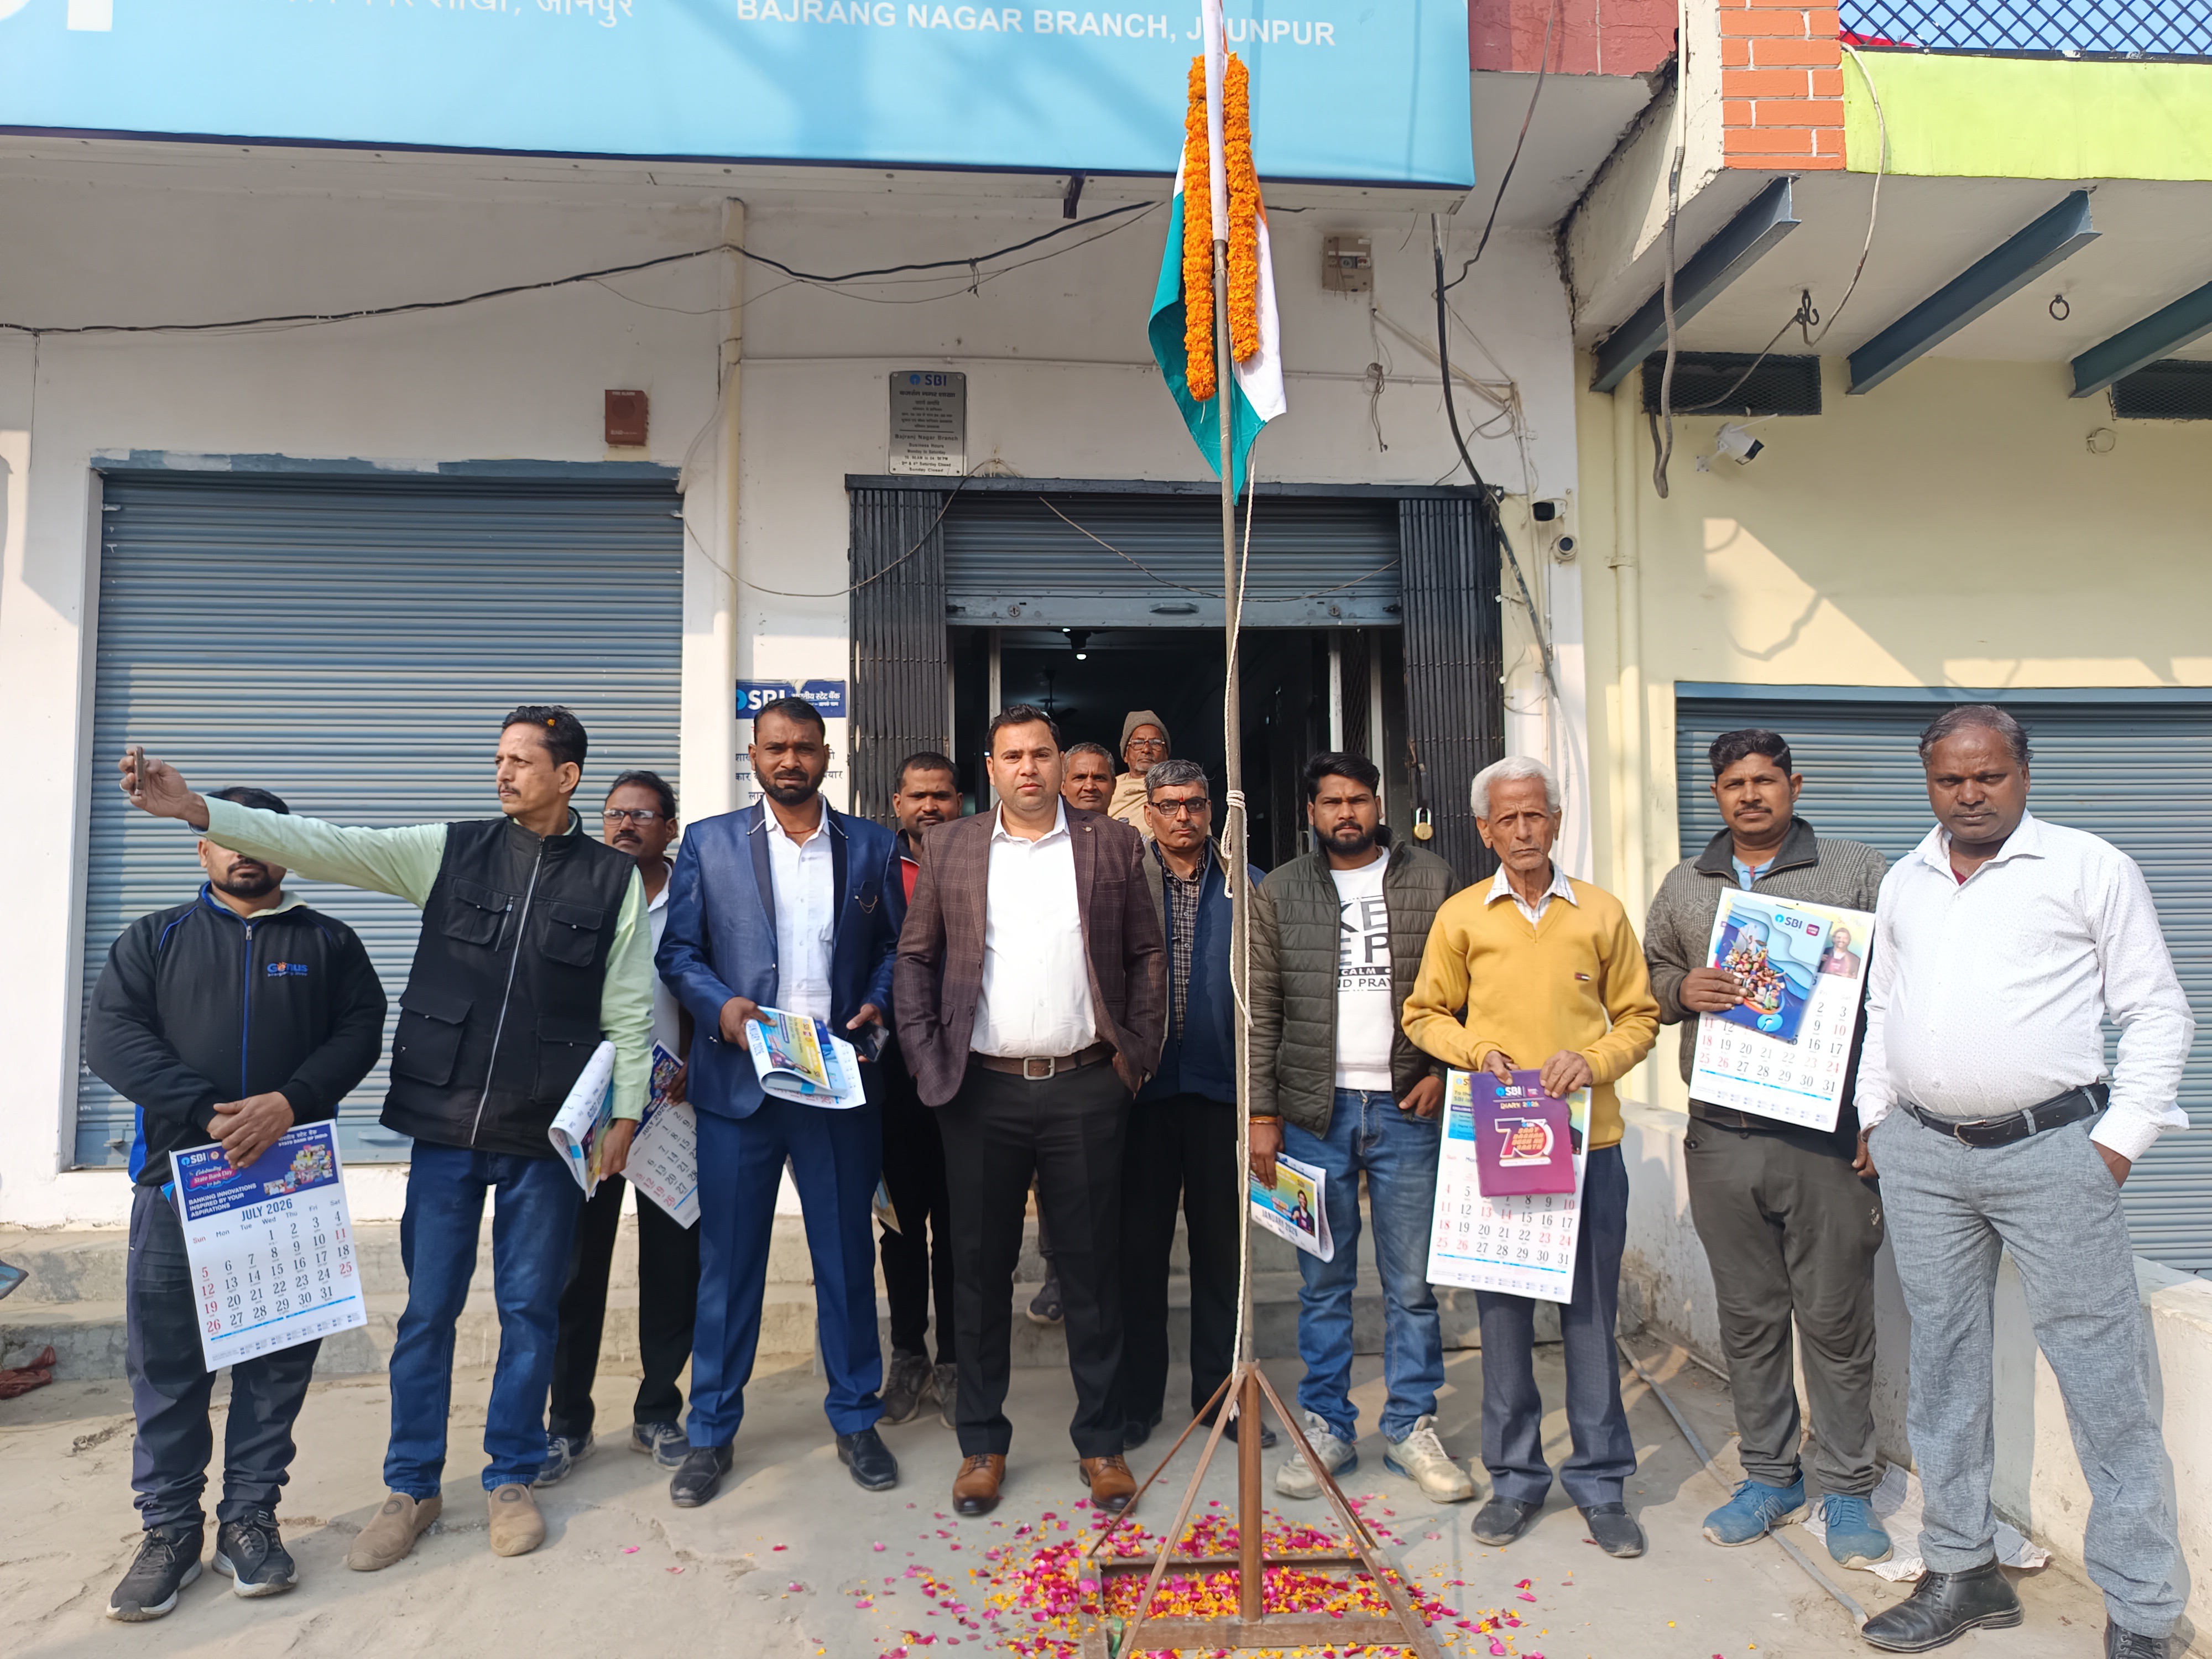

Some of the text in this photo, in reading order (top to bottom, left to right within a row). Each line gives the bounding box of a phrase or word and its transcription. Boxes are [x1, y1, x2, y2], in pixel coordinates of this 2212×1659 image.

[737, 0, 1335, 46] BAJRANG NAGAR BRANCH, JUNPUR
[925, 374, 946, 387] SBI
[1785, 916, 1803, 929] SBI
[1341, 967, 1376, 975] CALM
[1817, 1001, 1847, 1018] 2 3
[1705, 1017, 1714, 1029] 11
[1808, 1038, 1821, 1050] 16
[1830, 1042, 1843, 1055] 17
[1813, 1020, 1846, 1036] 9 10
[1703, 1035, 1839, 1074] 18 19 20 24
[1736, 1061, 1835, 1092] 27 28 29 30 31
[1505, 1086, 1522, 1096] SBI
[642, 1103, 669, 1136] JULY 2026
[190, 1152, 206, 1164] SBI
[208, 1171, 221, 1180] Bank
[222, 1170, 232, 1178] Day
[189, 1183, 257, 1205] BANKING INNOVATIONS
[190, 1199, 217, 1211] INSPIRED
[228, 1193, 244, 1203] YOUR
[1464, 1186, 1470, 1197] 5
[1545, 1196, 1552, 1207] 9
[1564, 1199, 1575, 1210] 10
[191, 1203, 231, 1217] ASPIRATIONS
[242, 1198, 293, 1221] JULY 2026
[1442, 1202, 1573, 1228] 11 12 13 14 15 16 17
[216, 1229, 229, 1238] Mon
[262, 1217, 276, 1225] Wed
[269, 1211, 341, 1240] 1 2 3 4
[1439, 1219, 1571, 1246] 18 19 20 21 22 23 24
[202, 1228, 346, 1278] 5 6 7 8 9 10 11
[1476, 1241, 1568, 1265] 27 28 29 30 31
[202, 1244, 350, 1296] 12 13 14 15 16 17 18
[205, 1261, 352, 1314] 19 20 21 22 23 24 25
[206, 1286, 332, 1333] 26 27 28 29 30 31
